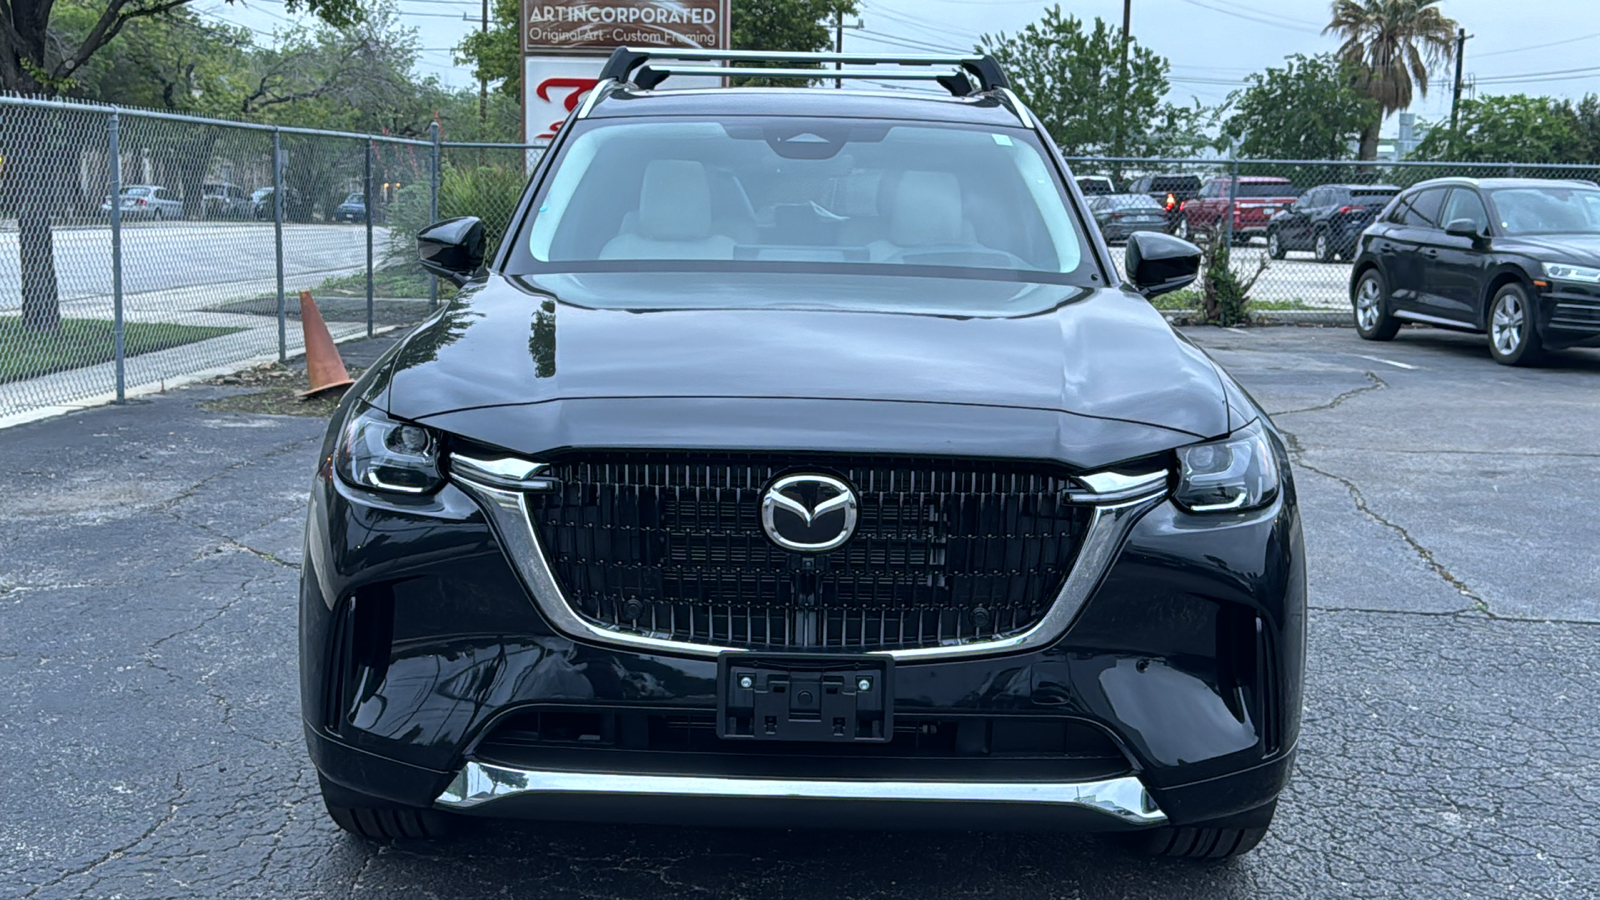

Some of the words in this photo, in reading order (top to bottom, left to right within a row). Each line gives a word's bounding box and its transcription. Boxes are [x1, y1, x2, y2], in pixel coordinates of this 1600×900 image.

[529, 27, 580, 44] Original
[583, 29, 604, 41] Art
[612, 28, 661, 42] Custom
